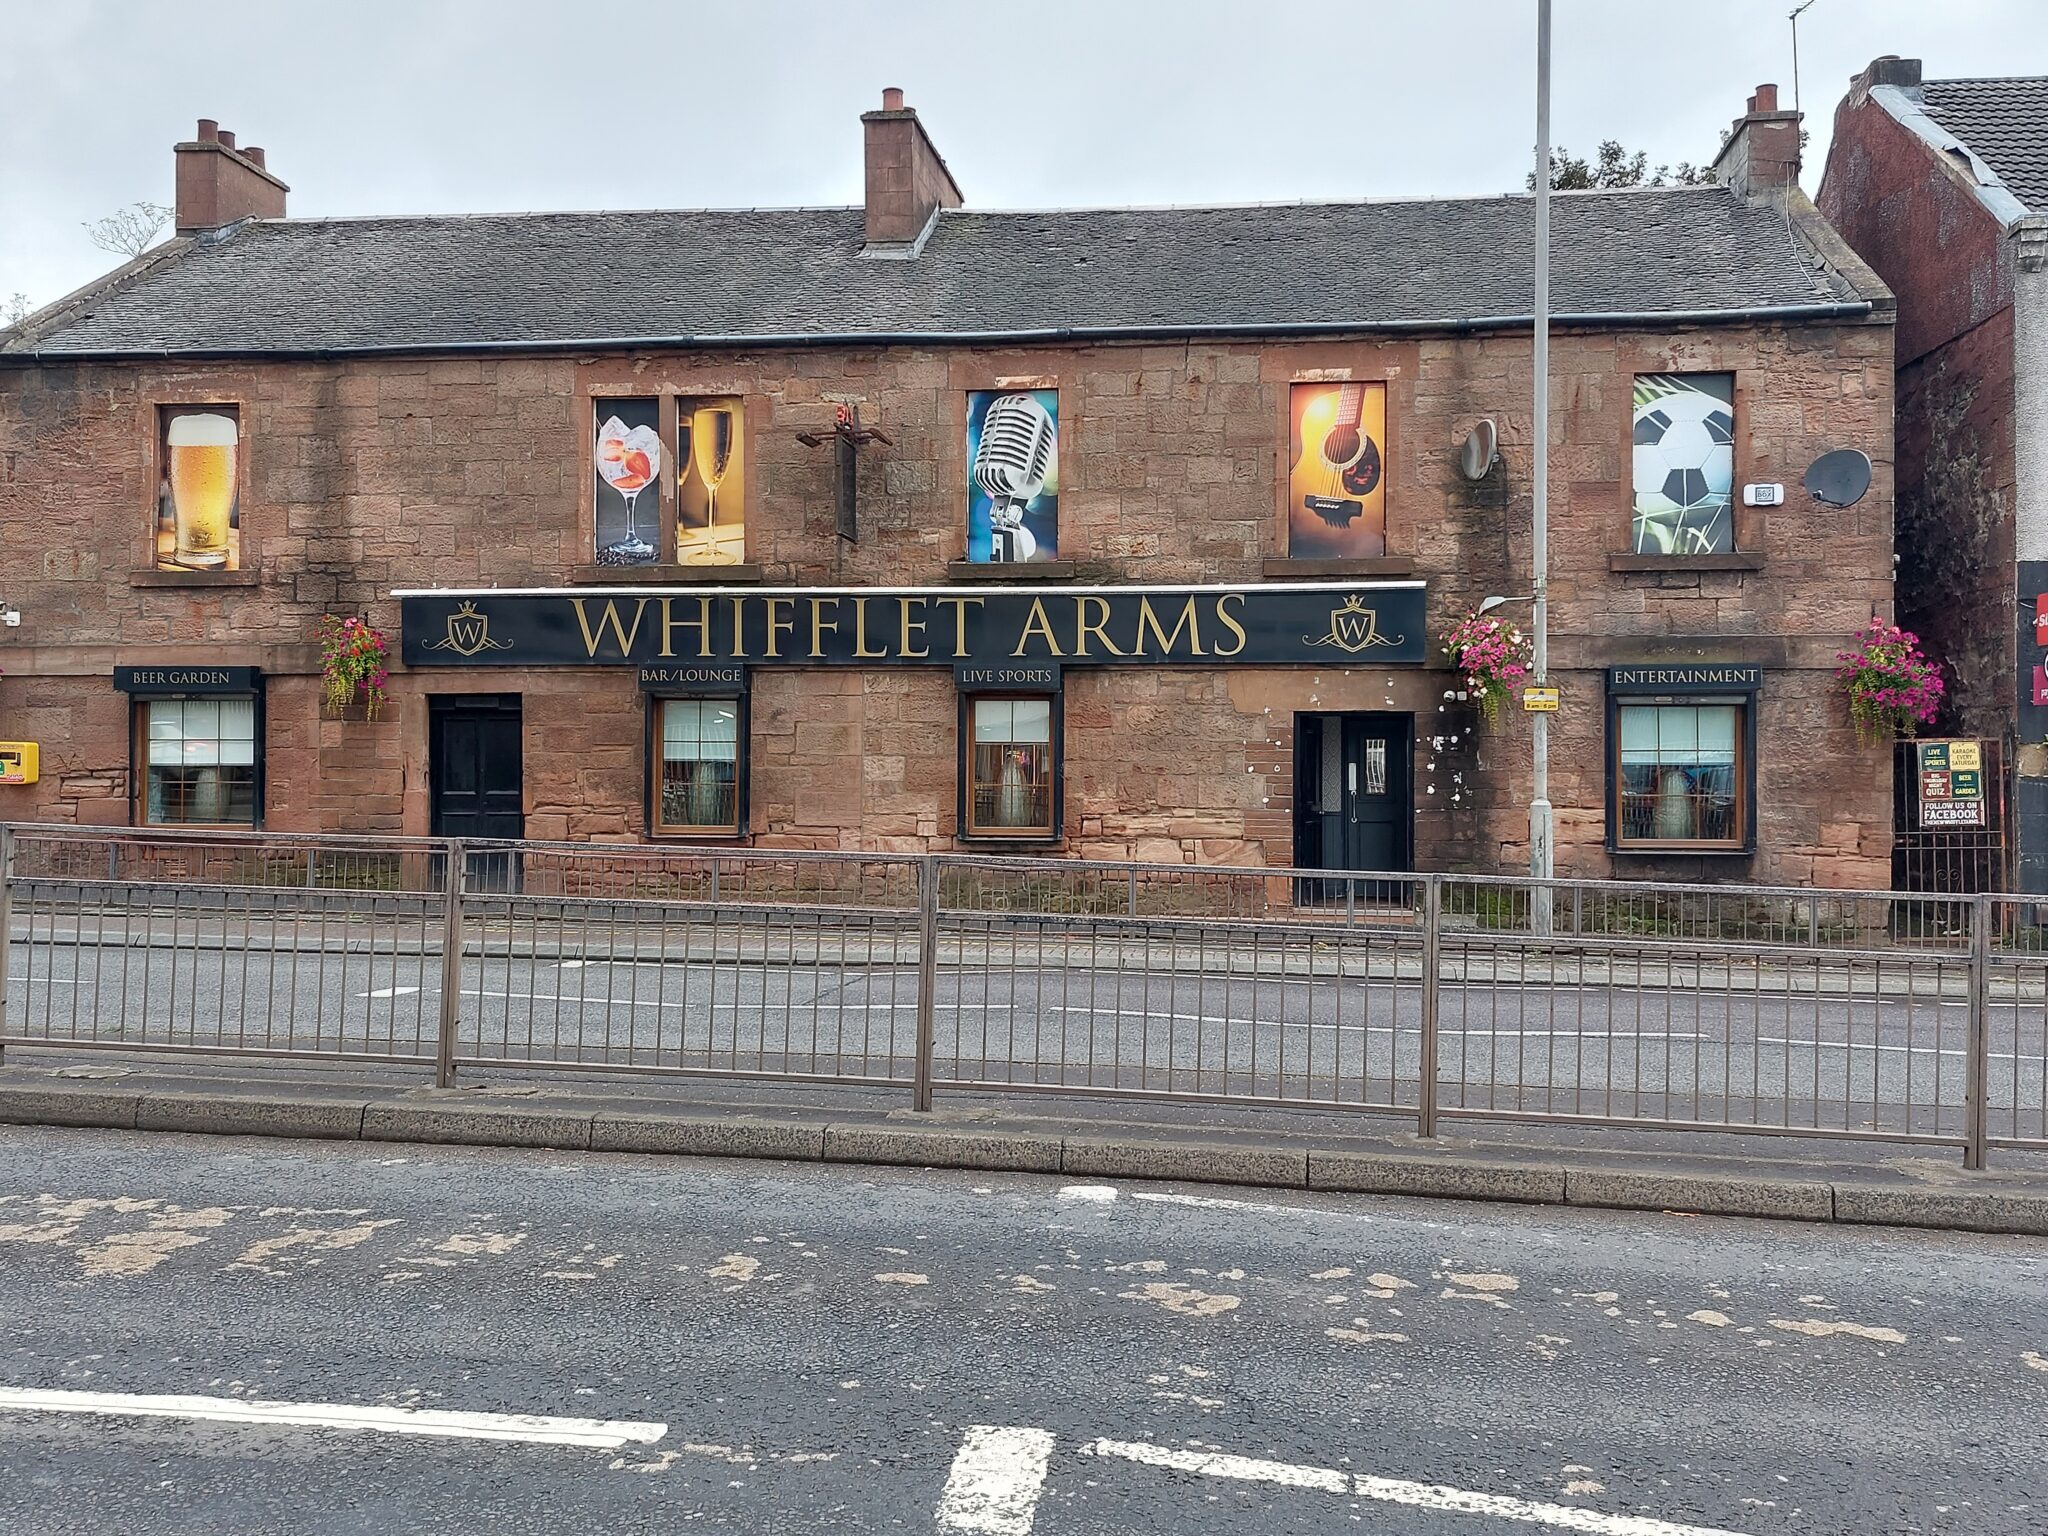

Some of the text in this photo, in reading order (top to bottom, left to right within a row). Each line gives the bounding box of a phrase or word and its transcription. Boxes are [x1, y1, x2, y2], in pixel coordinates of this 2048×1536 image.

[568, 593, 1247, 658] WHIFFLET ARMS
[1336, 617, 1369, 641] W
[453, 622, 482, 644] W
[133, 672, 230, 684] BEER GARDEN
[641, 669, 741, 682] BAR/LOUNGE
[962, 670, 1052, 682] LIVE SPORTS
[1615, 669, 1758, 684] ENTERTAINMENT
[1926, 788, 1945, 796] QUIZ
[1924, 810, 1978, 820] FACEBOOK
